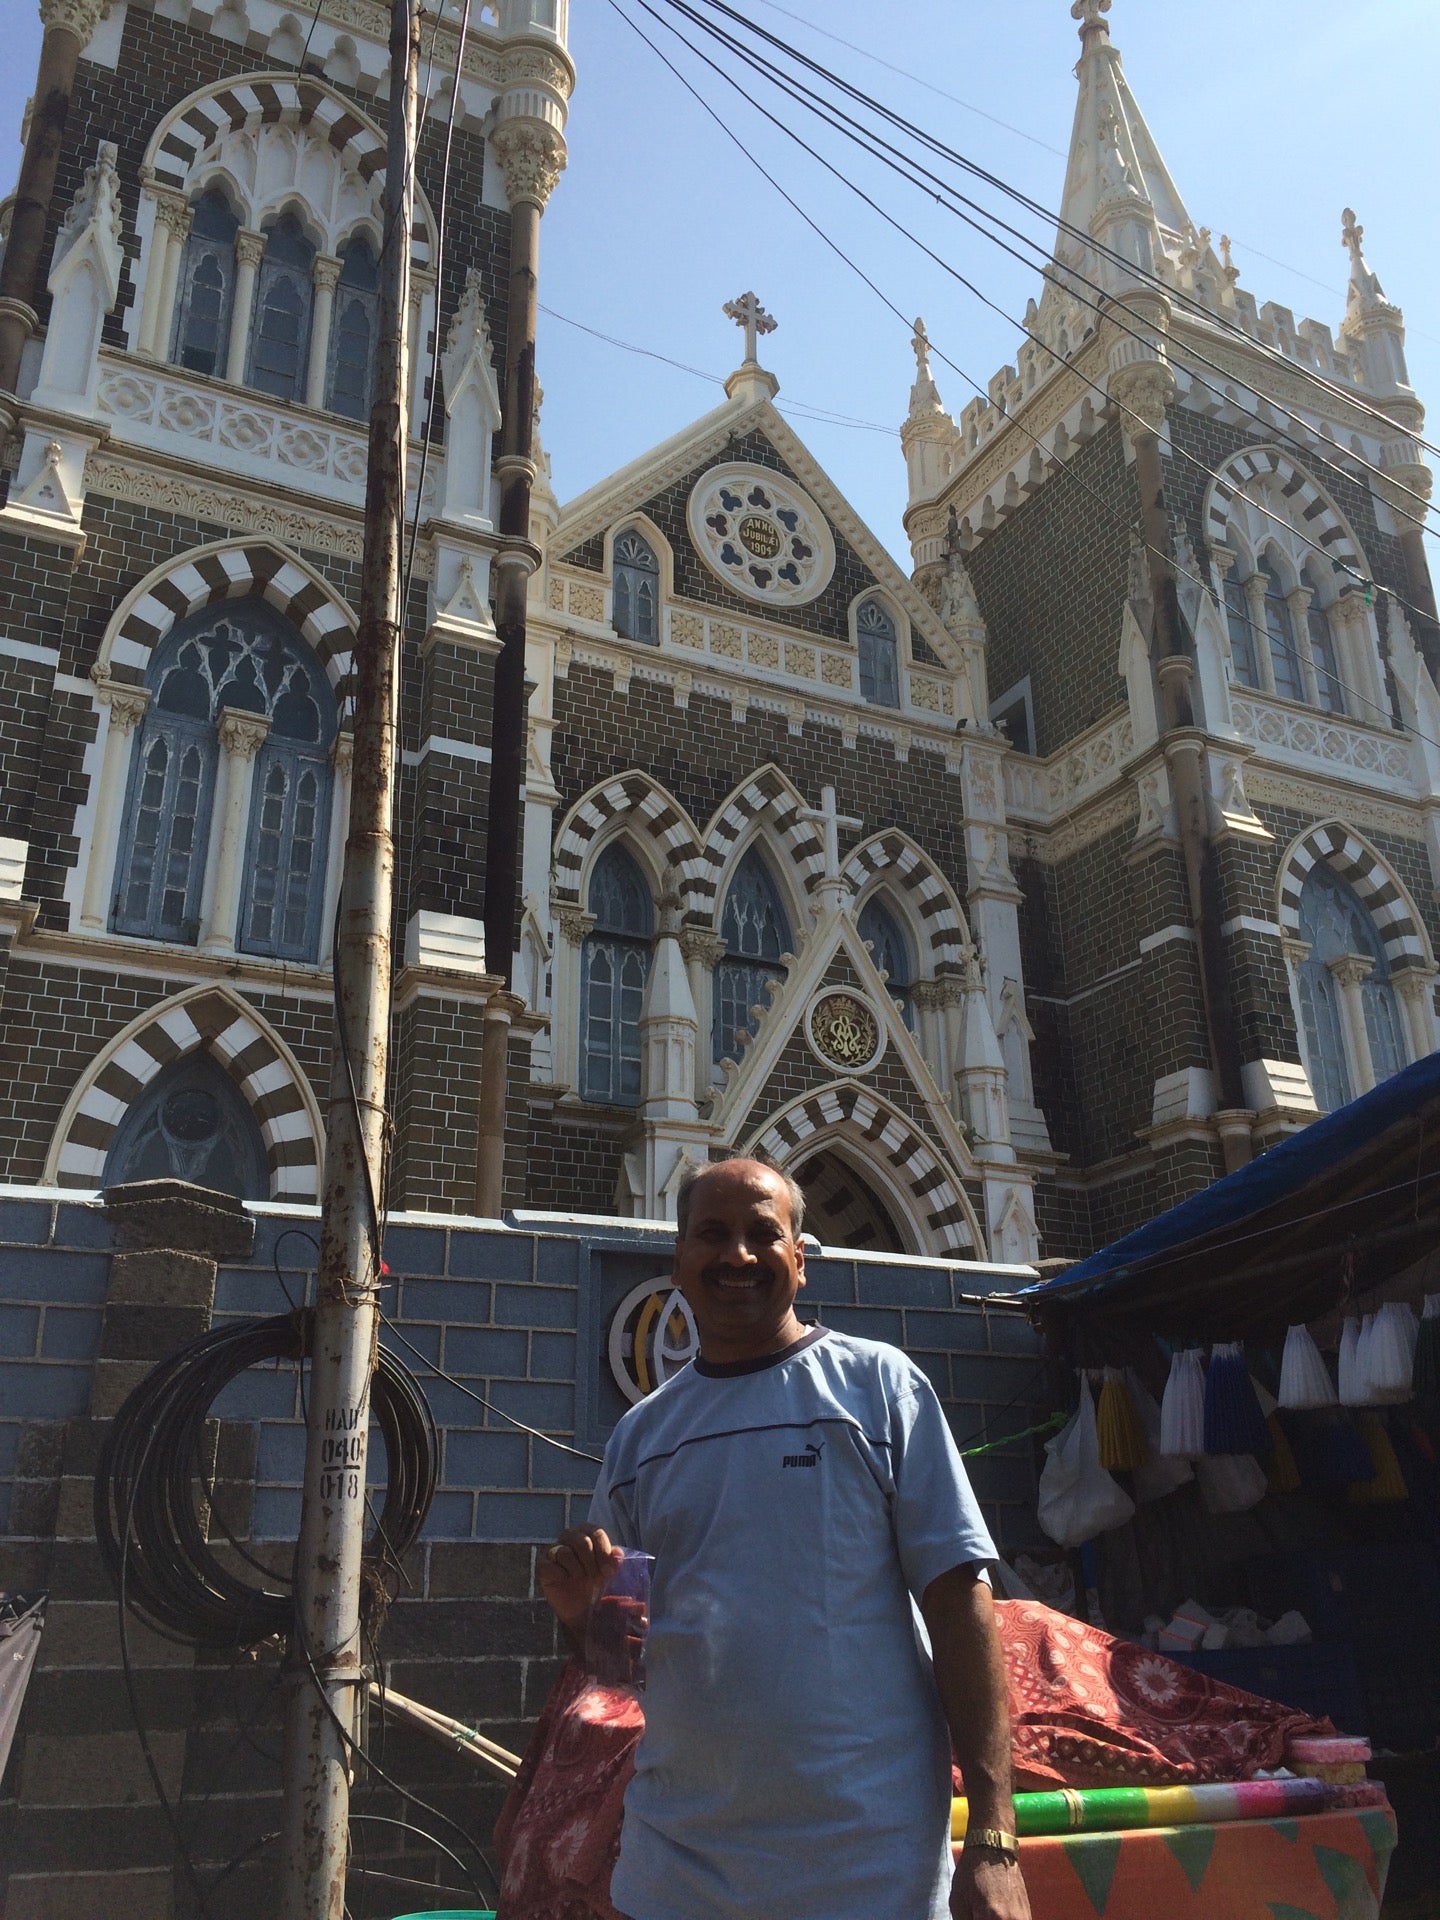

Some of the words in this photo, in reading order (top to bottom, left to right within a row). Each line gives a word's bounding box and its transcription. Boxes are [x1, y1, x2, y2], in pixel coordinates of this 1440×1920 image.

[746, 518, 774, 534] ANNO
[751, 541, 772, 555] 1904
[321, 1437, 360, 1464] 040
[783, 1454, 816, 1468] PUMA
